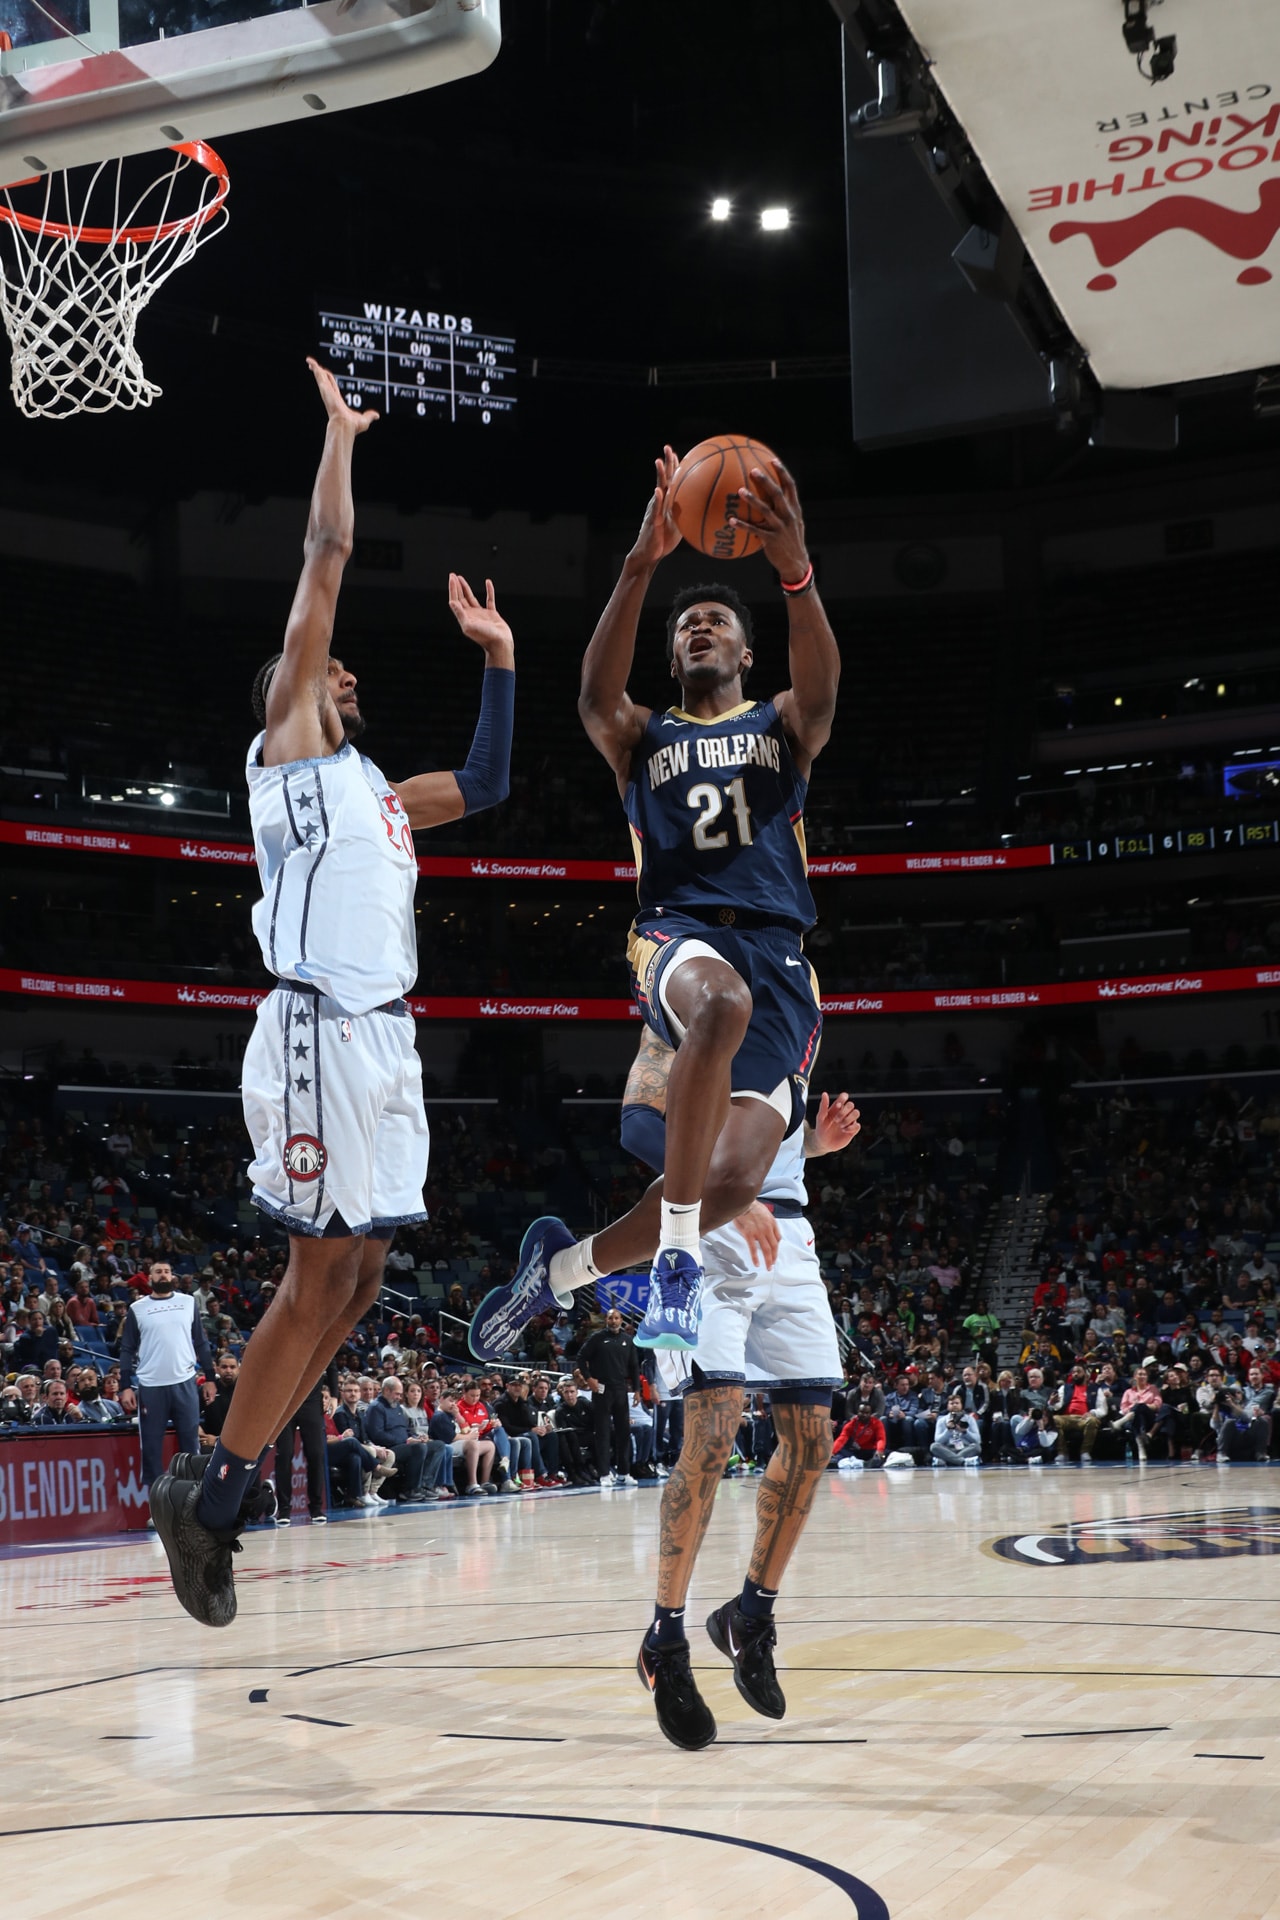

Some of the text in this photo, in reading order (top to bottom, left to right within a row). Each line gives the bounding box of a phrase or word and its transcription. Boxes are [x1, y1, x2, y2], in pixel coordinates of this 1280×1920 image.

[1096, 84, 1272, 133] CENTER
[1027, 139, 1280, 212] OOTHIE
[364, 302, 473, 334] WIZARDS
[333, 330, 375, 349] 50.0%
[410, 341, 431, 357] 0/0
[476, 351, 496, 366] 1/5
[347, 362, 354, 376] 1
[416, 372, 425, 386] 5
[480, 380, 490, 394] 6
[345, 392, 362, 408] 10
[416, 402, 426, 416] 6
[482, 410, 492, 425] 0
[647, 733, 780, 792] NEW ORLEANS
[686, 777, 754, 850] 21
[25, 829, 117, 849] WELCOME TO THE BLENDER
[1062, 846, 1079, 859] FL
[1098, 843, 1108, 856] 0
[1163, 836, 1173, 848] 6
[1187, 832, 1205, 846] RB
[1224, 829, 1234, 842] 7
[906, 858, 942, 869] WELCOME
[961, 855, 993, 866] BLENDER
[1256, 971, 1280, 984] WELC
[21, 976, 56, 992] WELCOME
[75, 983, 110, 996] BLENDER
[820, 1000, 855, 1012] OOTHIE
[934, 995, 972, 1006] WELCOME
[992, 992, 1026, 1004] BLENDER
